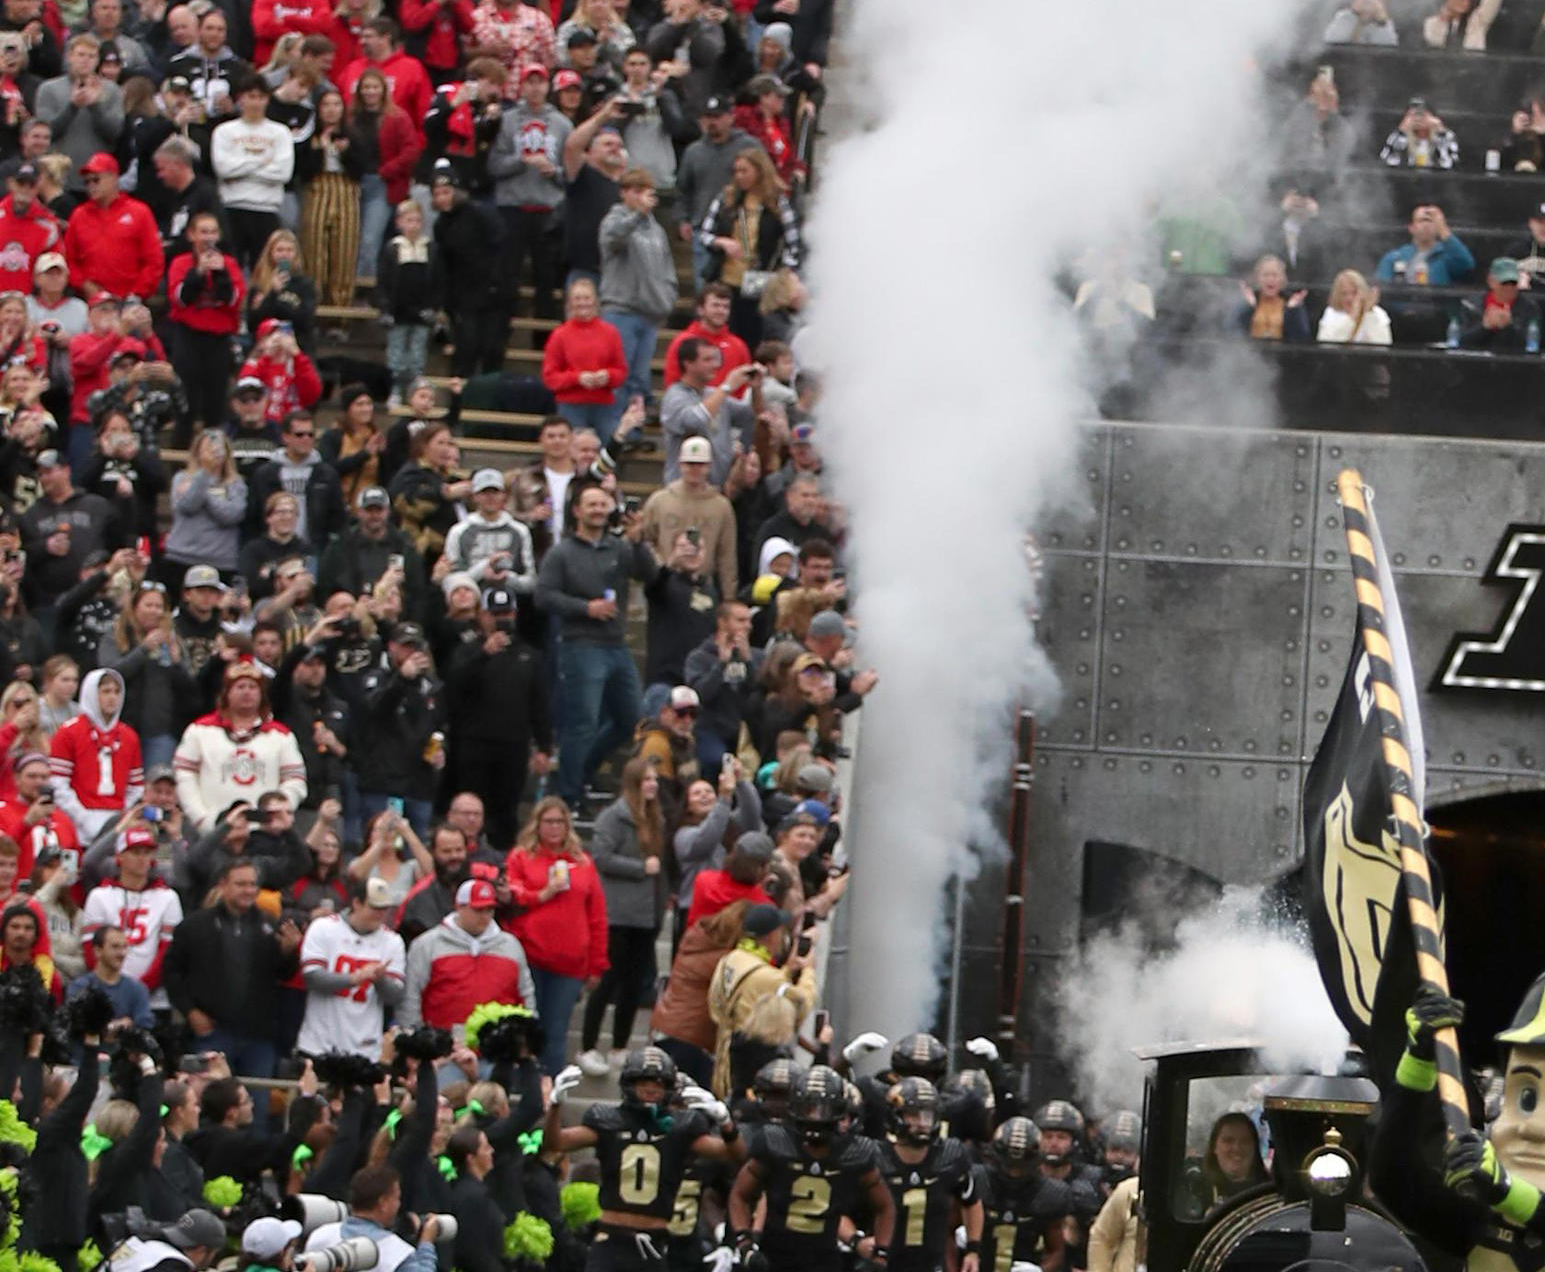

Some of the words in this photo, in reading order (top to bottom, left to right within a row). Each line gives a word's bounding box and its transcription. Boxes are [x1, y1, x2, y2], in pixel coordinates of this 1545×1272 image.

[96, 746, 116, 796] 1
[117, 907, 148, 946] 15
[619, 1143, 661, 1206] 0
[785, 1175, 832, 1234] 2
[902, 1188, 928, 1246] 1
